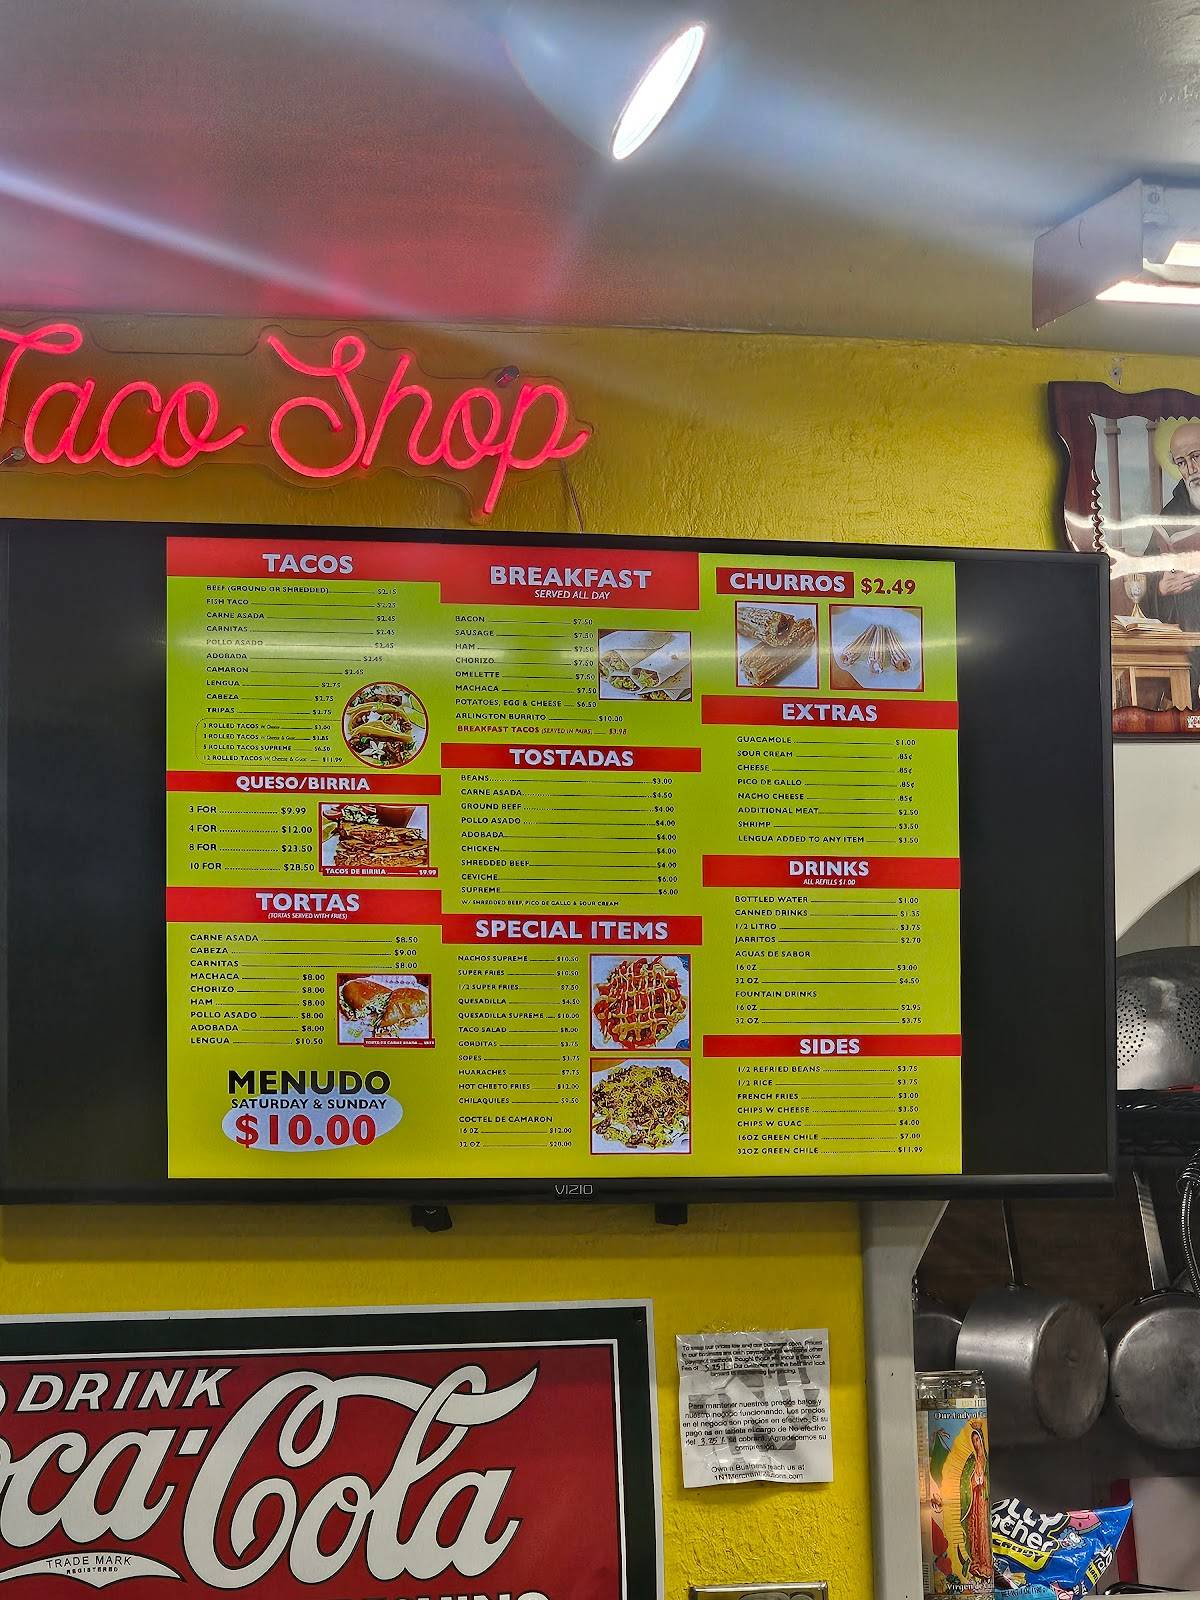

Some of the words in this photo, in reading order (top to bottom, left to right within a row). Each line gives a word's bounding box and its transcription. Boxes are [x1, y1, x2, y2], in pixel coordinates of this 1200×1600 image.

[0, 323, 248, 467] Taco
[267, 335, 590, 513] Shop
[263, 554, 353, 574] TACOS
[490, 566, 652, 588] BREAKFAST
[730, 572, 845, 592] CHURROS
[861, 578, 916, 595] $2.49
[535, 590, 570, 598] SERVED
[572, 590, 589, 599] ALL
[591, 591, 610, 600] DAY
[456, 699, 500, 707] POTATOES,
[783, 703, 877, 722] EXTRAS
[510, 749, 633, 766] TOSTADAS
[237, 776, 370, 792] QUESO/BIRRIA
[281, 807, 306, 815] $9.99
[190, 824, 194, 832] 4
[197, 824, 217, 832] FOR
[281, 826, 312, 834] $12.00
[190, 843, 194, 851] 8
[197, 843, 216, 851] FOR
[281, 845, 312, 853] $23.50
[284, 864, 315, 872] $28.50
[789, 861, 869, 877] DRINKS
[256, 893, 360, 911] TORTAS
[476, 920, 582, 939] SPECIAL
[592, 922, 668, 940] ITEMS
[800, 1039, 860, 1055] SIDES
[228, 1070, 390, 1095] MENUDO
[232, 1099, 309, 1109] SATURDAY
[313, 1099, 322, 1109] &
[328, 1099, 387, 1109] SUNDAY
[235, 1113, 376, 1148] $10.00
[554, 1184, 593, 1196] VIZIO
[16, 1369, 240, 1412] DRINK
[0, 1364, 539, 1590] ca-Cola
[46, 1556, 89, 1568] TRADE
[95, 1555, 132, 1566] MARK
[66, 1566, 118, 1575] REGISTERED
